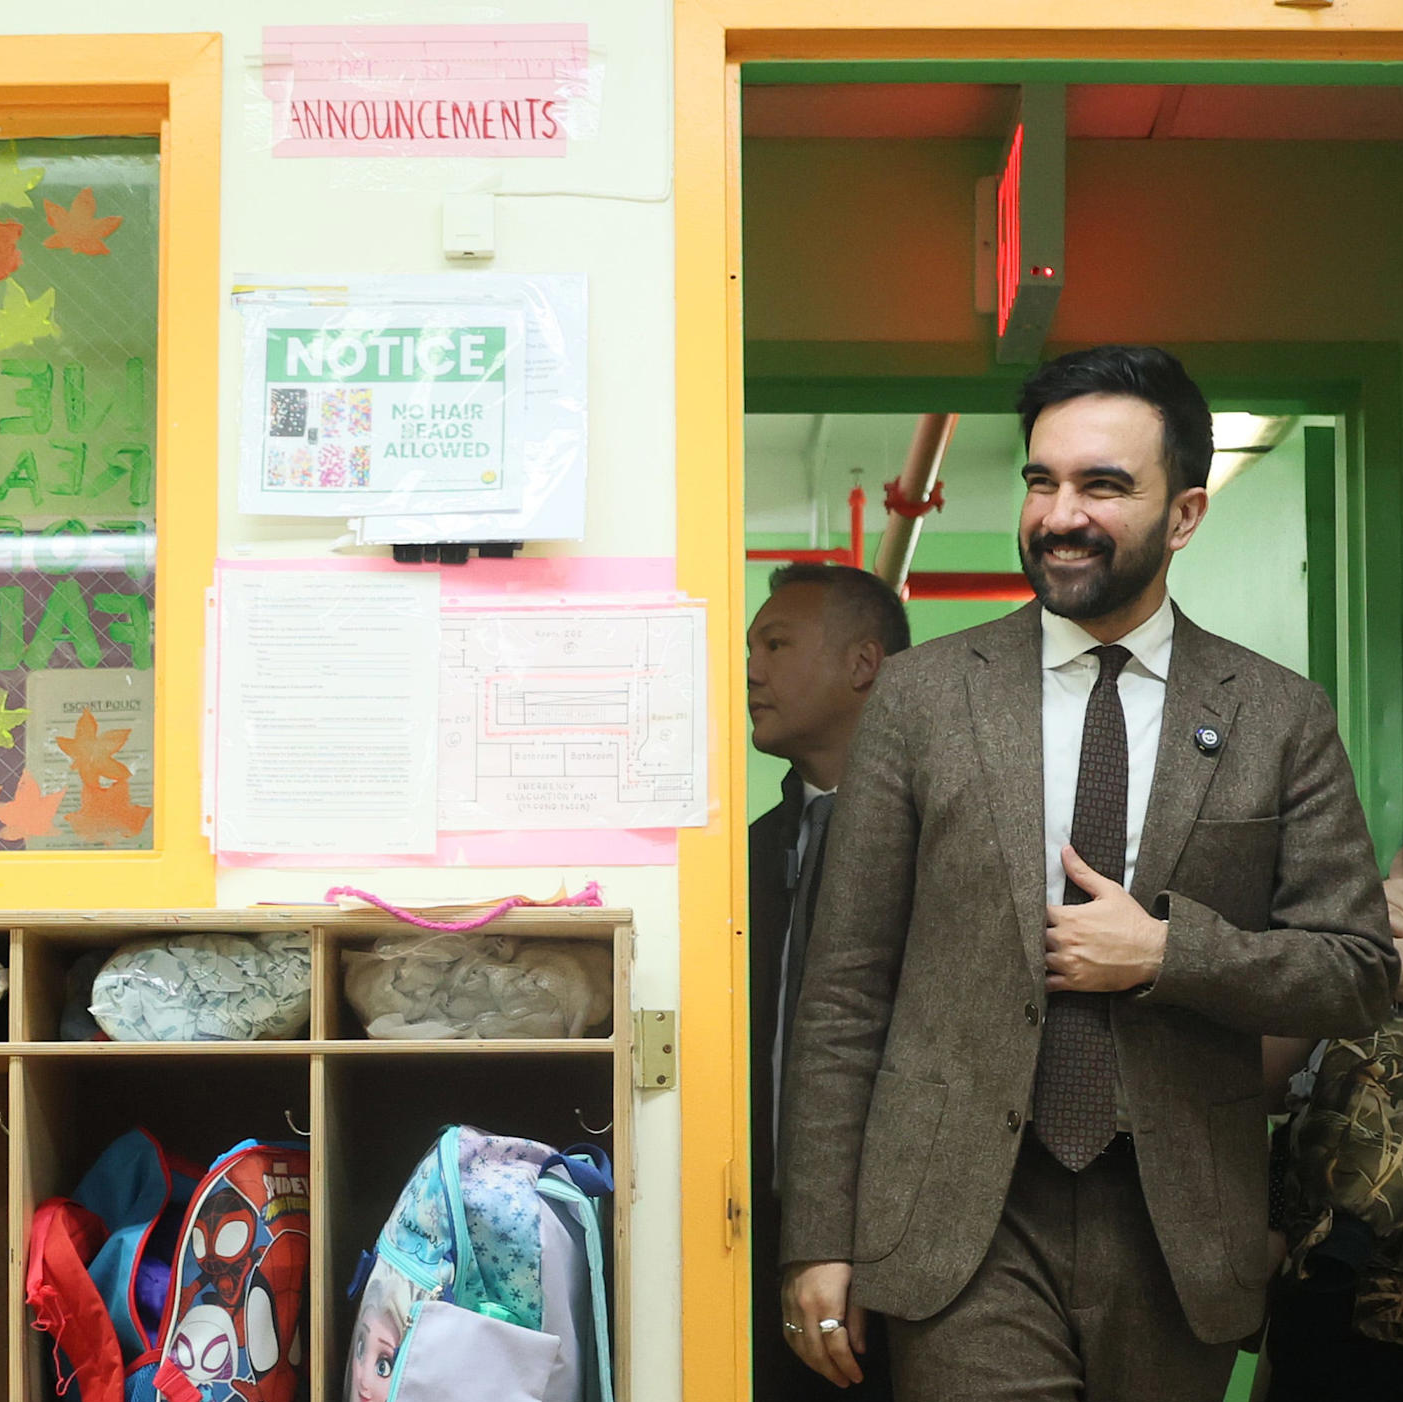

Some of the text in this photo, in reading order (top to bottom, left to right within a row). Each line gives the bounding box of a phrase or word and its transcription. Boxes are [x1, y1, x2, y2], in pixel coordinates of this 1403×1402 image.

[291, 97, 559, 141] ANNOUNCEMENTS
[286, 335, 487, 378] NOTICE
[391, 403, 484, 421] NO HAIR
[401, 423, 474, 440] BEADS
[383, 442, 490, 459] ALLOWED
[105, 700, 142, 711] POLICY
[506, 792, 598, 801] EVACUATION PLAN
